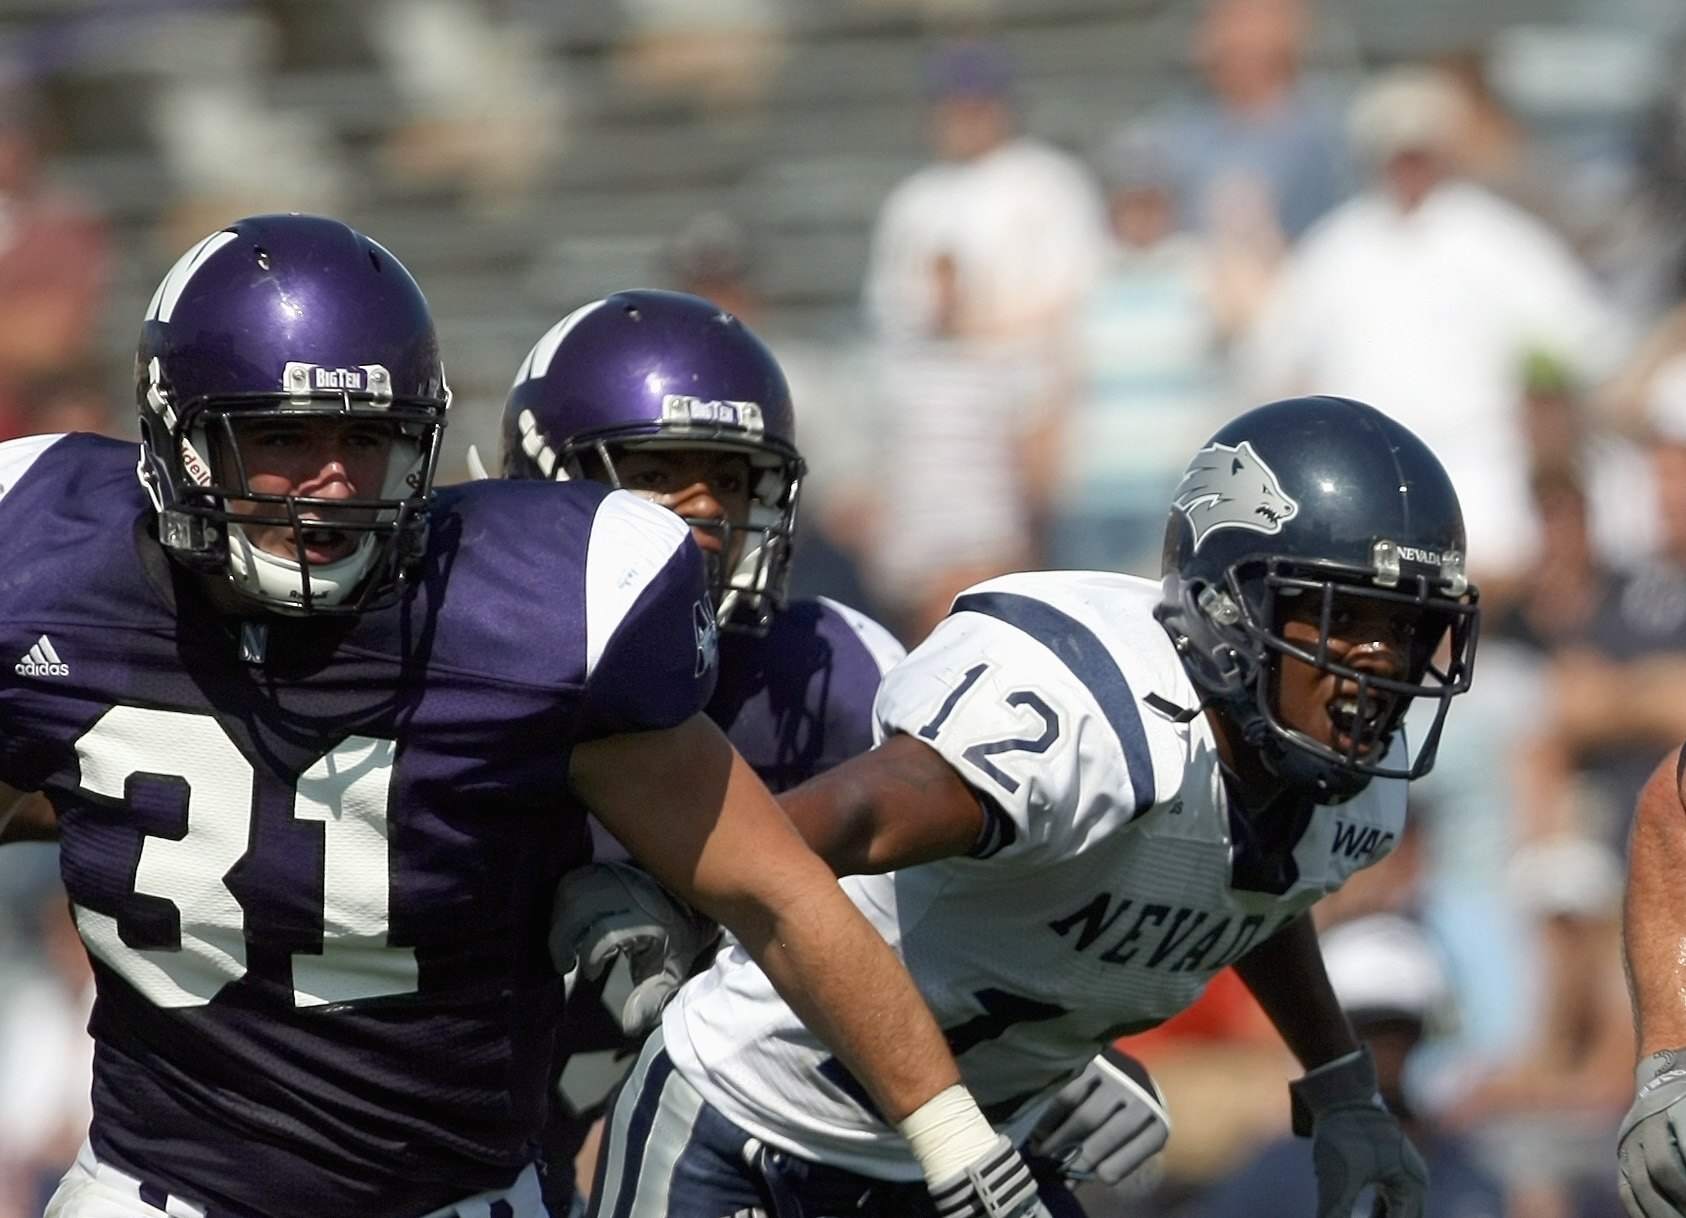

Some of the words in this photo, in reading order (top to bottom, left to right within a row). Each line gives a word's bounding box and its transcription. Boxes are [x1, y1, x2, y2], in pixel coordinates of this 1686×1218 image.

[14, 661, 70, 677] adidas
[918, 662, 1060, 795] 12
[75, 704, 419, 1008] 31
[1048, 892, 1295, 974] NEVAD
